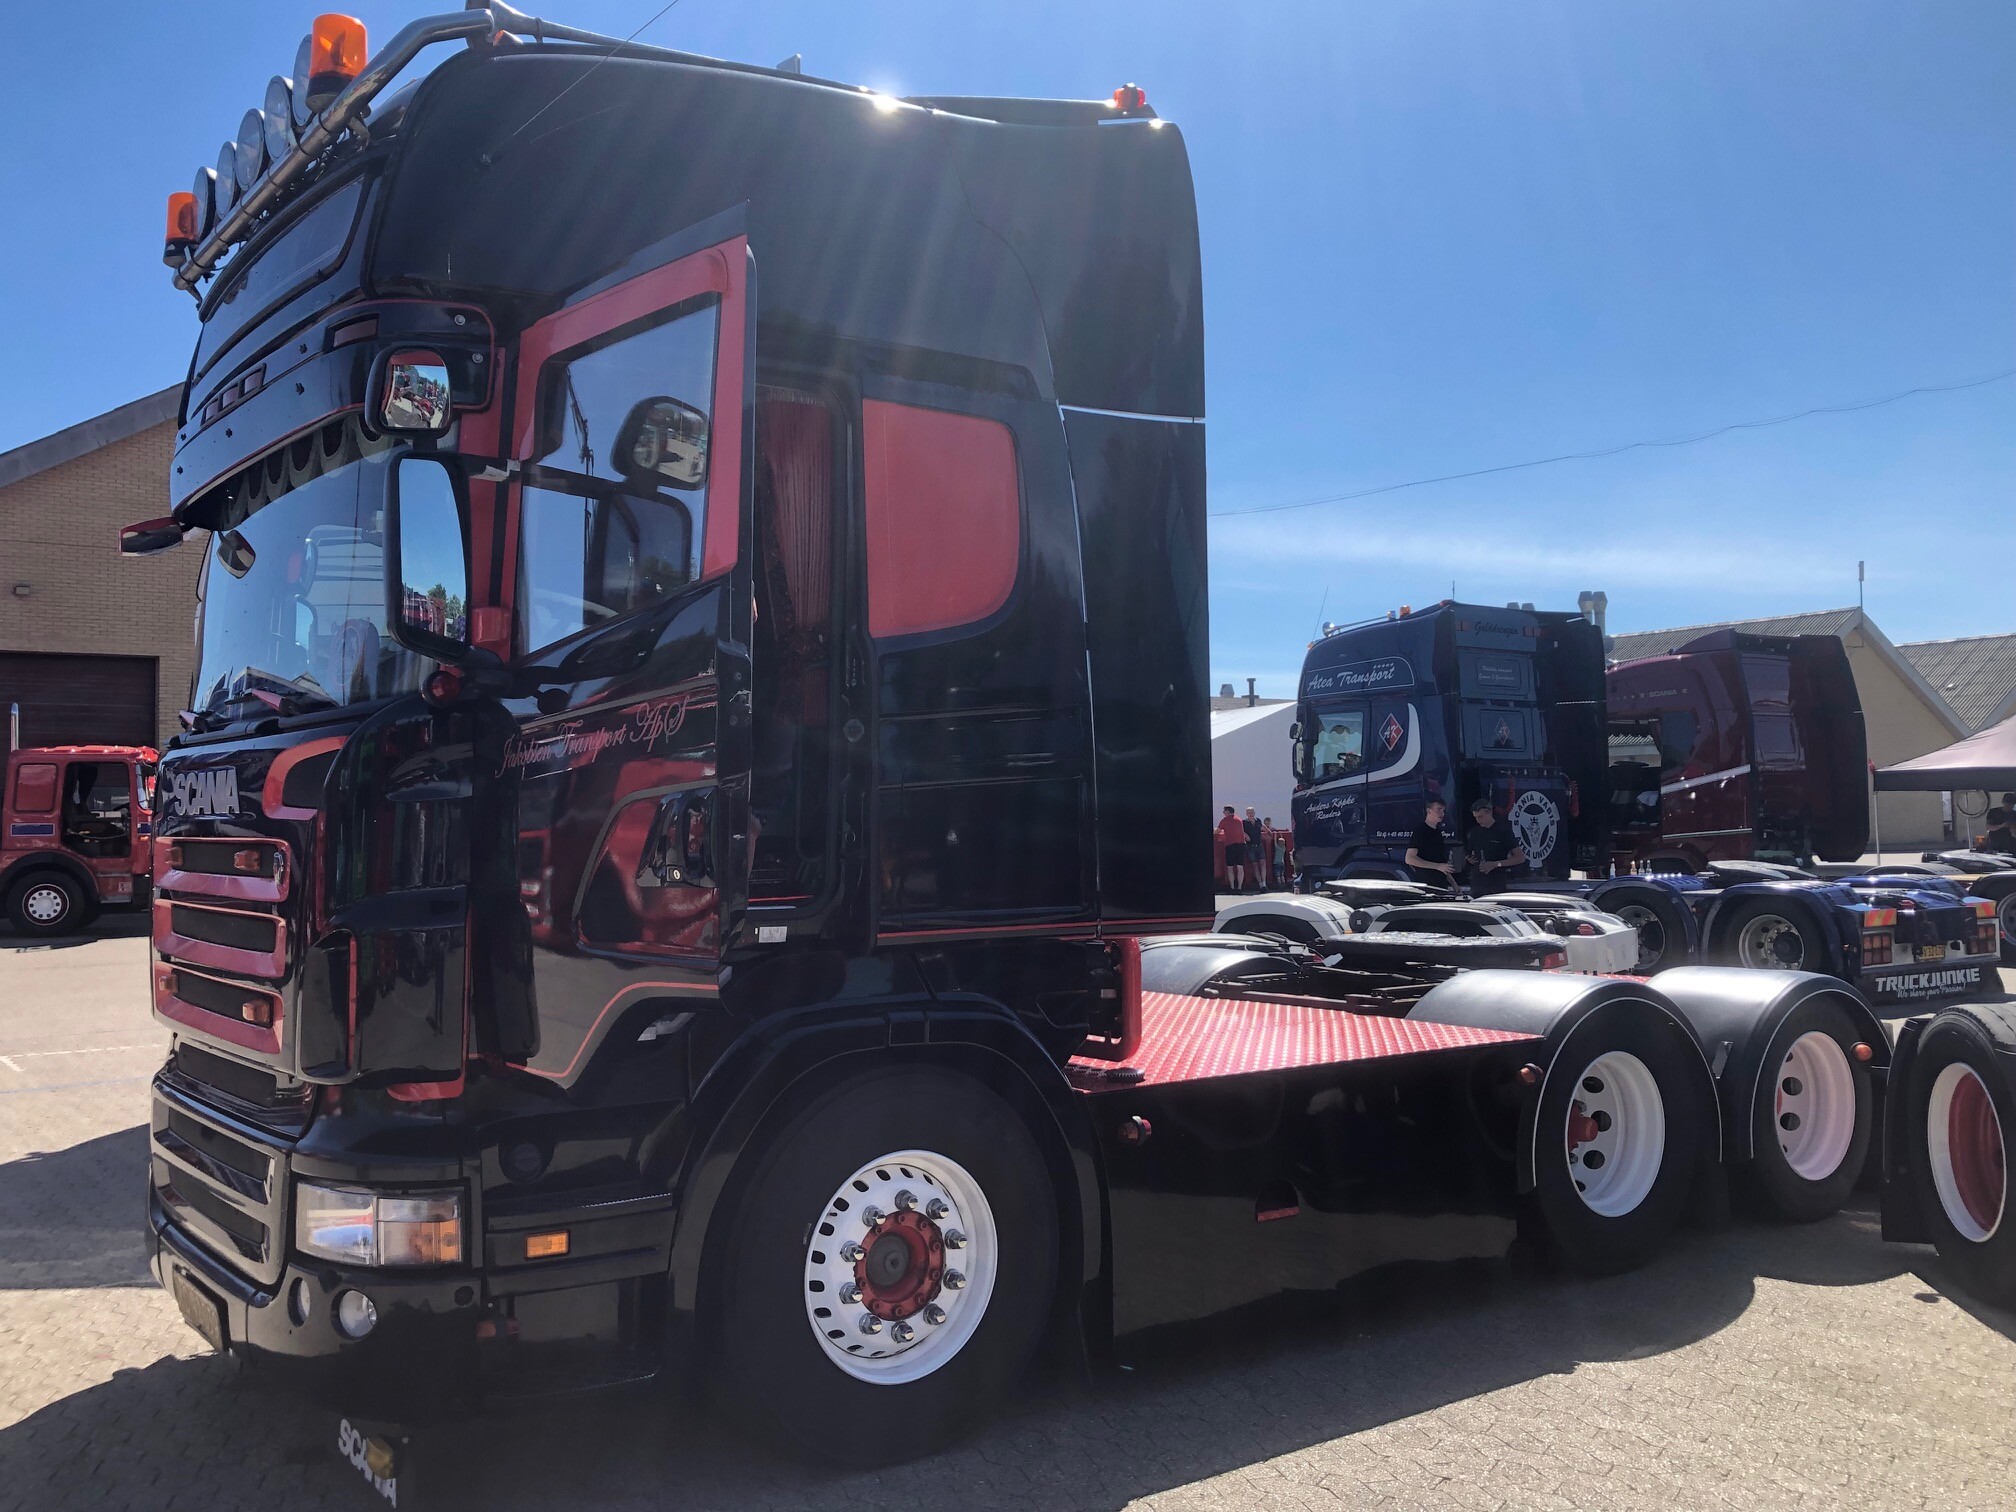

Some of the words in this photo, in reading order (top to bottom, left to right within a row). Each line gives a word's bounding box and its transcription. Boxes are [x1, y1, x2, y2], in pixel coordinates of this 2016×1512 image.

[1307, 674, 1334, 691] Atea
[1337, 666, 1395, 687] Transport
[1649, 689, 1678, 697] SCANIA
[495, 733, 552, 778] Jakobsen
[555, 719, 627, 763] Transport
[630, 696, 690, 753] ApS
[1384, 725, 1398, 739] AK
[174, 768, 240, 816] SCANIA
[1304, 802, 1330, 814] Anders
[1316, 810, 1342, 820] Randers
[1513, 794, 1535, 826] SCANIA
[1539, 796, 1556, 827] VABIS
[1532, 835, 1554, 860] UNITED
[1875, 968, 1981, 992] TRUCKJUNKIE
[1897, 987, 1909, 998] We
[1909, 987, 1926, 998] share
[1926, 989, 1941, 1000] your
